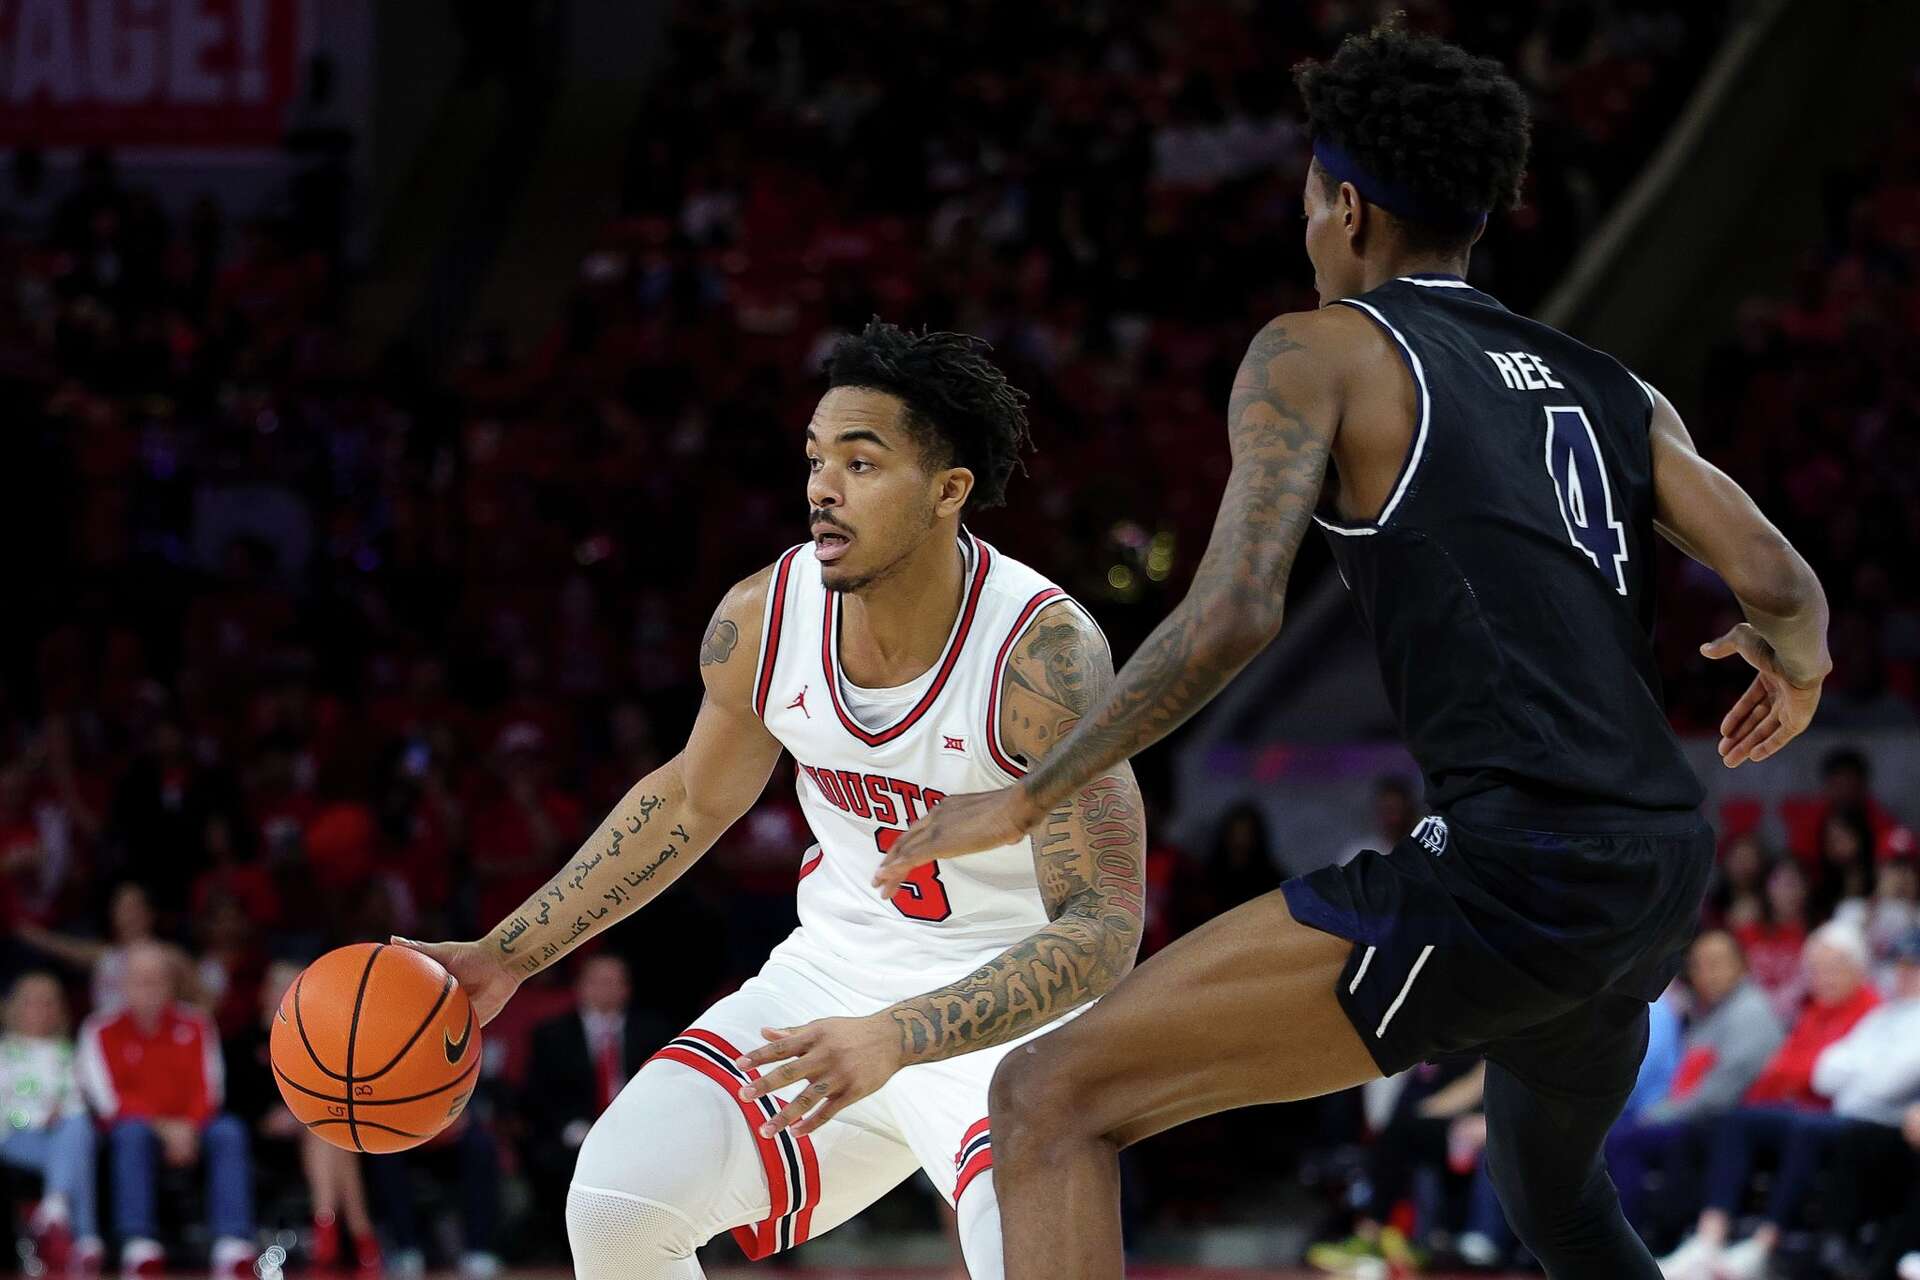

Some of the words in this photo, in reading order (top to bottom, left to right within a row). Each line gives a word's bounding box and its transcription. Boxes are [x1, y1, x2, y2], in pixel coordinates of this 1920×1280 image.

[0, 0, 270, 108] AGE!
[1484, 350, 1566, 391] REE
[1543, 405, 1630, 596] 4
[607, 828, 625, 857] في
[670, 824, 690, 844] لا
[873, 826, 953, 922] 3
[535, 899, 551, 925] في
